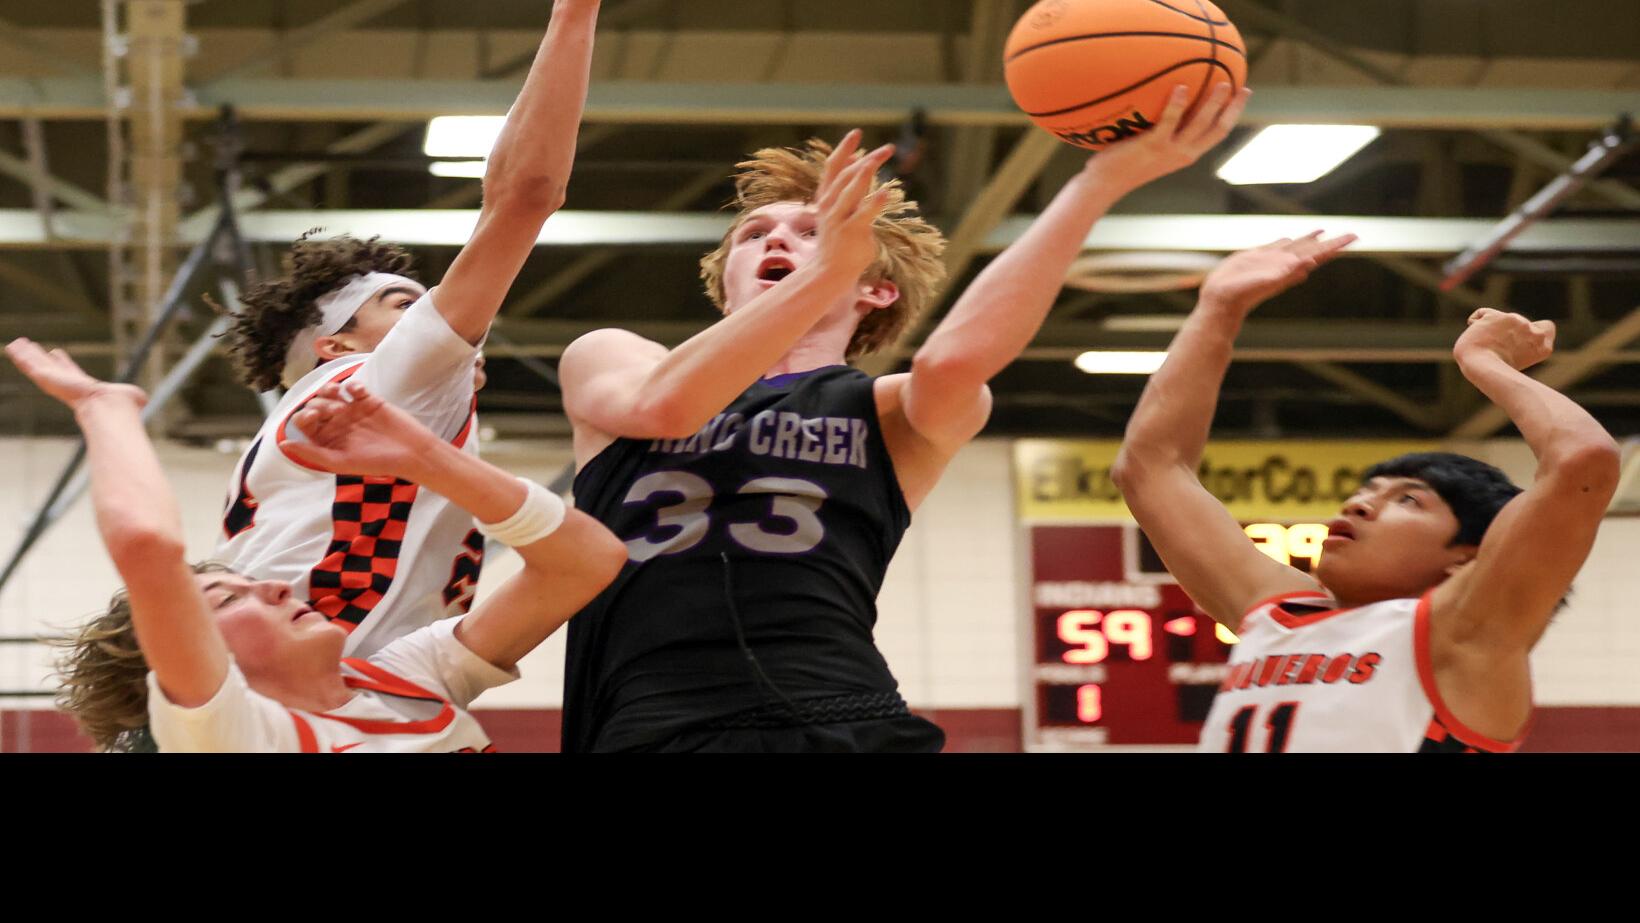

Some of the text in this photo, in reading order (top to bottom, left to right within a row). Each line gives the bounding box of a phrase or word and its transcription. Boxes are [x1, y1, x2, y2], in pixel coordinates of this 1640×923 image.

[748, 409, 870, 469] CREEK
[622, 469, 830, 562] 33
[1057, 610, 1152, 664] 59
[1077, 684, 1102, 722] 1
[1225, 701, 1302, 752] 11
